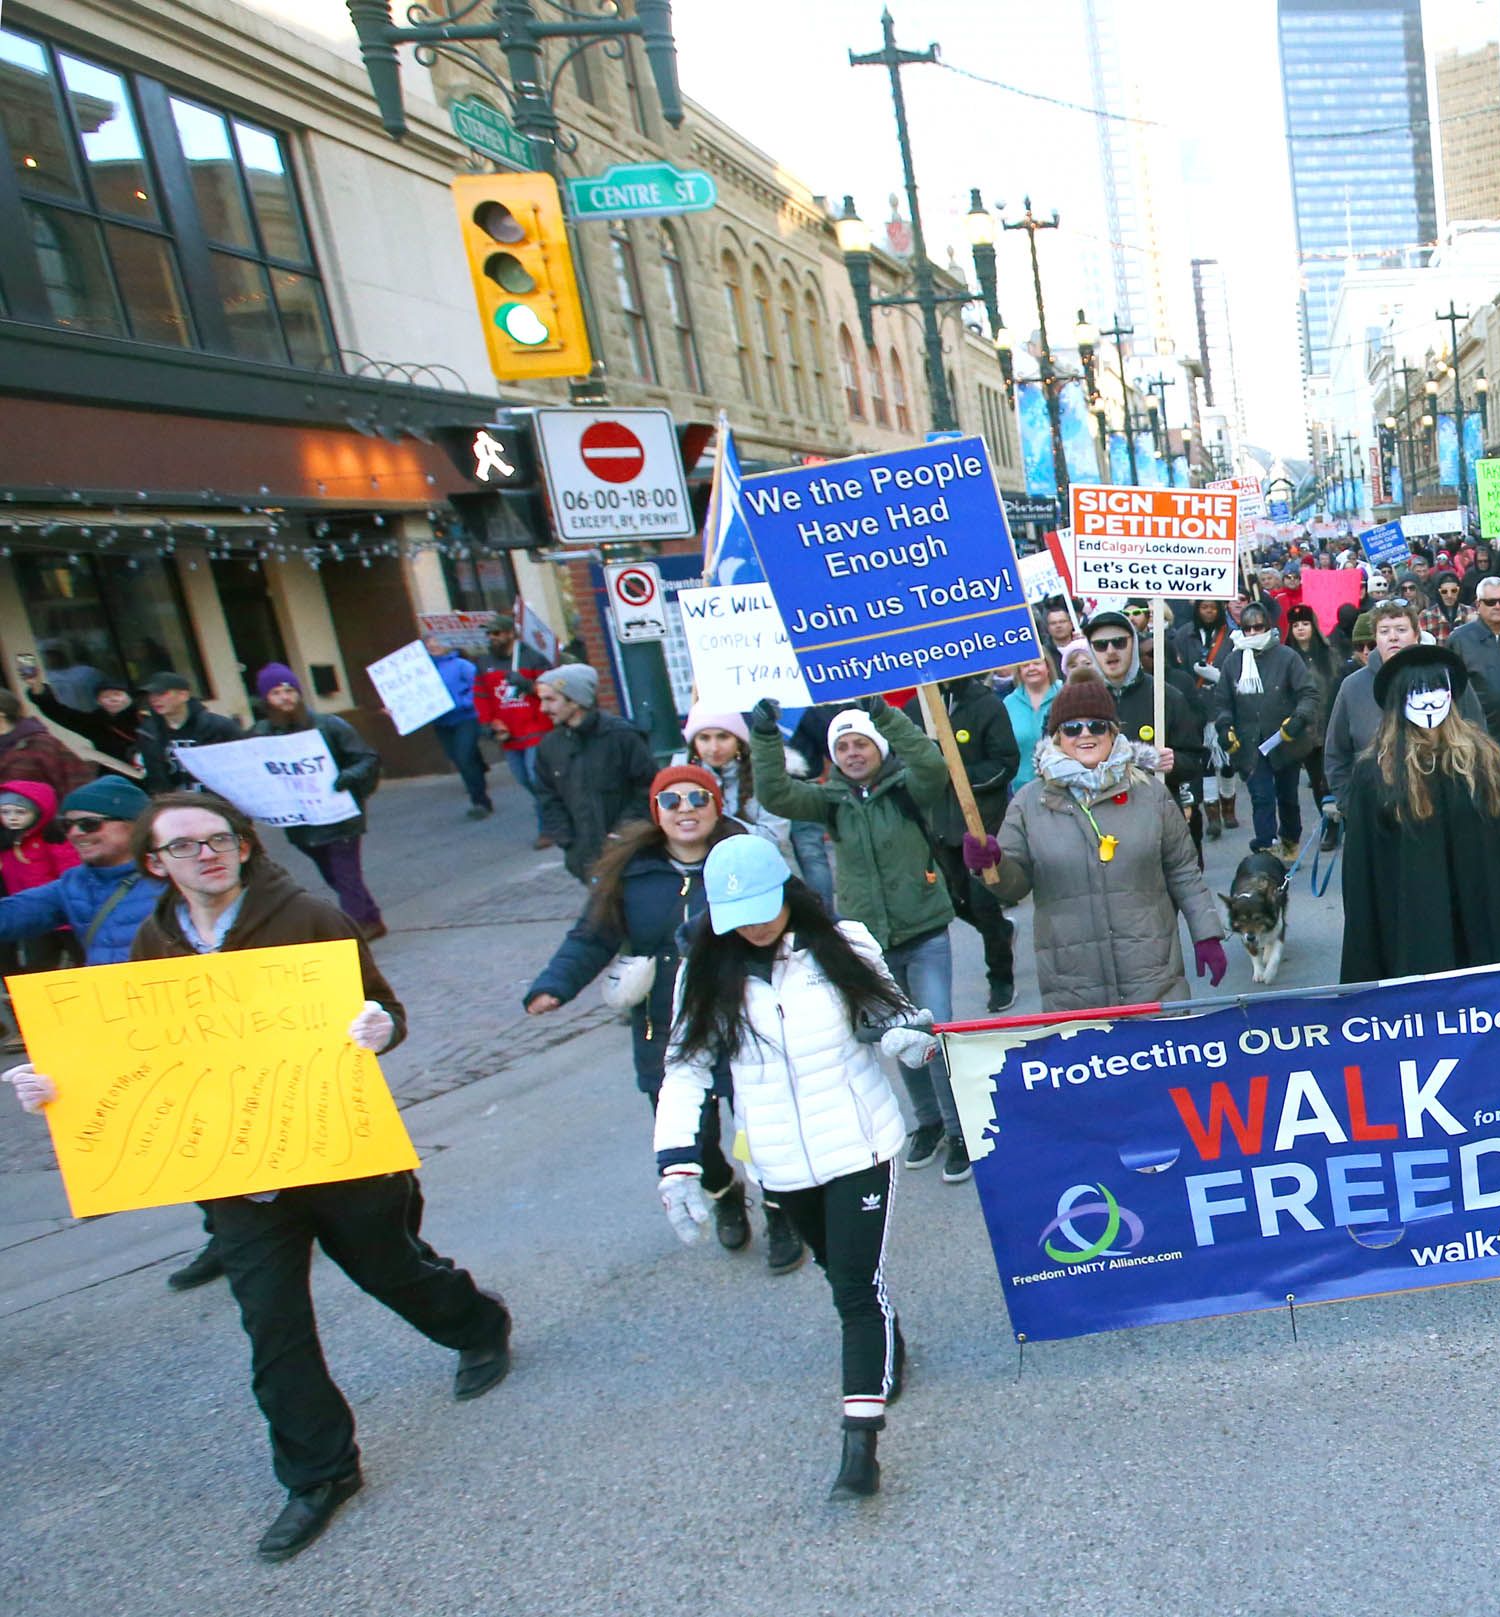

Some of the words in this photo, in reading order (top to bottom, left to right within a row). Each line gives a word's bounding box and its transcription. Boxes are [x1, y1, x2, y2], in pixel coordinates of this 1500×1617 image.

[590, 183, 662, 209] CENTRE
[674, 180, 697, 201] ST
[744, 487, 802, 516] We
[808, 477, 864, 507] the
[869, 452, 984, 495] People
[562, 489, 678, 510] 06:00-18:00
[1079, 490, 1154, 514] SIGN
[1170, 495, 1233, 518] THE
[570, 514, 614, 529] EXCEPT
[620, 514, 634, 527] BY
[639, 511, 679, 527] PERMIT
[797, 515, 880, 548] Have
[885, 496, 951, 531] Had
[1083, 514, 1227, 539] PETITION
[824, 534, 949, 579] Enough
[1078, 539, 1232, 556] EndCalgaryLockdown.com
[1083, 561, 1123, 575] Let's
[1128, 563, 1158, 576] Get
[1162, 563, 1227, 580] Calgary
[1097, 577, 1140, 590] Back
[1145, 579, 1162, 592] to
[1167, 579, 1213, 593] Work
[684, 597, 725, 618] WE
[731, 596, 772, 615] WILL
[791, 602, 859, 634] Join
[866, 596, 905, 620] us
[909, 568, 1014, 611] Today!
[699, 632, 762, 651] COMPLY
[806, 625, 1033, 685] Unifythepeople.ca
[726, 664, 800, 685] TYRAN
[264, 756, 326, 776] BEAST
[44, 970, 240, 1026] FLATTEN
[259, 959, 324, 987] THE
[126, 1001, 329, 1052] CURVES!!!
[1021, 1039, 1228, 1091] Protecting
[1238, 1023, 1331, 1056] OUR
[1341, 1013, 1424, 1043] Civil
[1168, 1058, 1469, 1161] WALK
[179, 1112, 208, 1158] DEBT
[1012, 1269, 1066, 1287] Freedom
[1067, 1261, 1106, 1276] UNITY
[1109, 1250, 1183, 1270] Alliance.com
